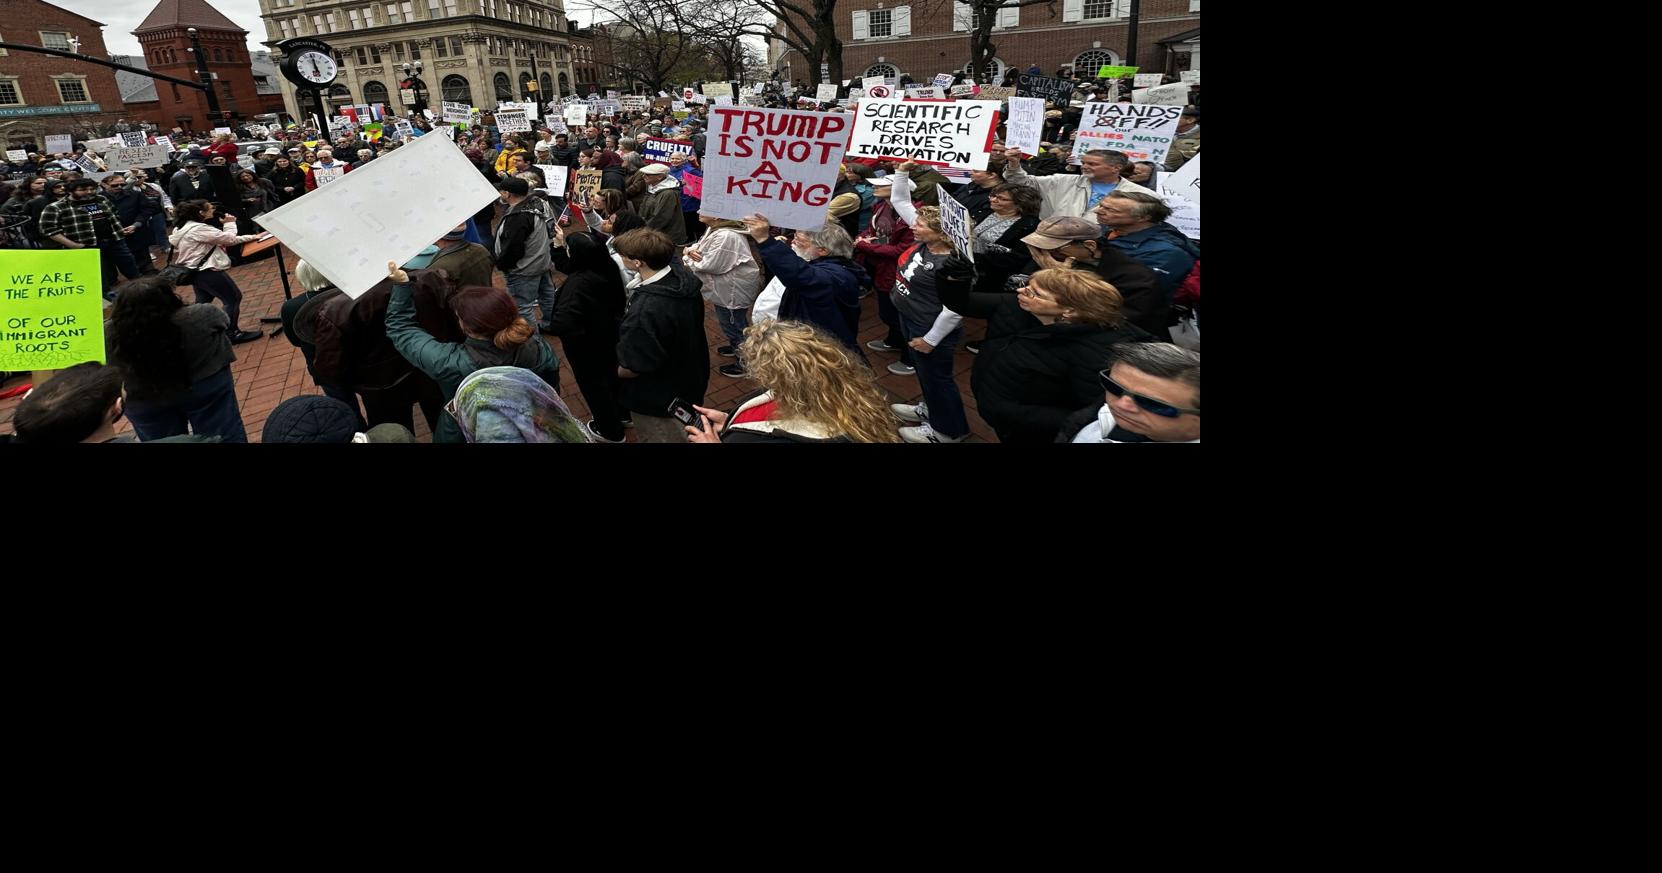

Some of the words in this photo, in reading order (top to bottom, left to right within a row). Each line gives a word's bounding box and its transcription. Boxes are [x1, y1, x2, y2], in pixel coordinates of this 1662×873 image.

[1019, 74, 1075, 92] CAPITALISM
[496, 112, 526, 120] STRONGER
[864, 102, 983, 121] SCIENTIFIC
[1089, 104, 1182, 119] HANDS
[714, 109, 846, 139] TRUMP
[871, 120, 970, 136] RESEARCH
[879, 134, 954, 149] DRIVES
[1079, 130, 1124, 140] ALLIES
[1131, 134, 1170, 144] NATO
[646, 140, 693, 156] CRUELTY
[718, 133, 754, 158] IS
[761, 139, 842, 165] NOT
[1106, 141, 1136, 149] FDA
[645, 153, 671, 163] UN-AME
[858, 144, 971, 164] INNOVATION
[750, 160, 783, 181] A
[575, 173, 602, 185] PROTECT
[726, 176, 832, 207] KING
[11, 274, 34, 285] WE
[40, 272, 73, 284] ARE
[4, 288, 29, 300] THE
[38, 285, 85, 298] FRUITS
[7, 317, 31, 329] OF
[40, 315, 76, 328] OUR
[0, 328, 87, 341] IMMIGRANT
[15, 341, 70, 353] ROOTS
